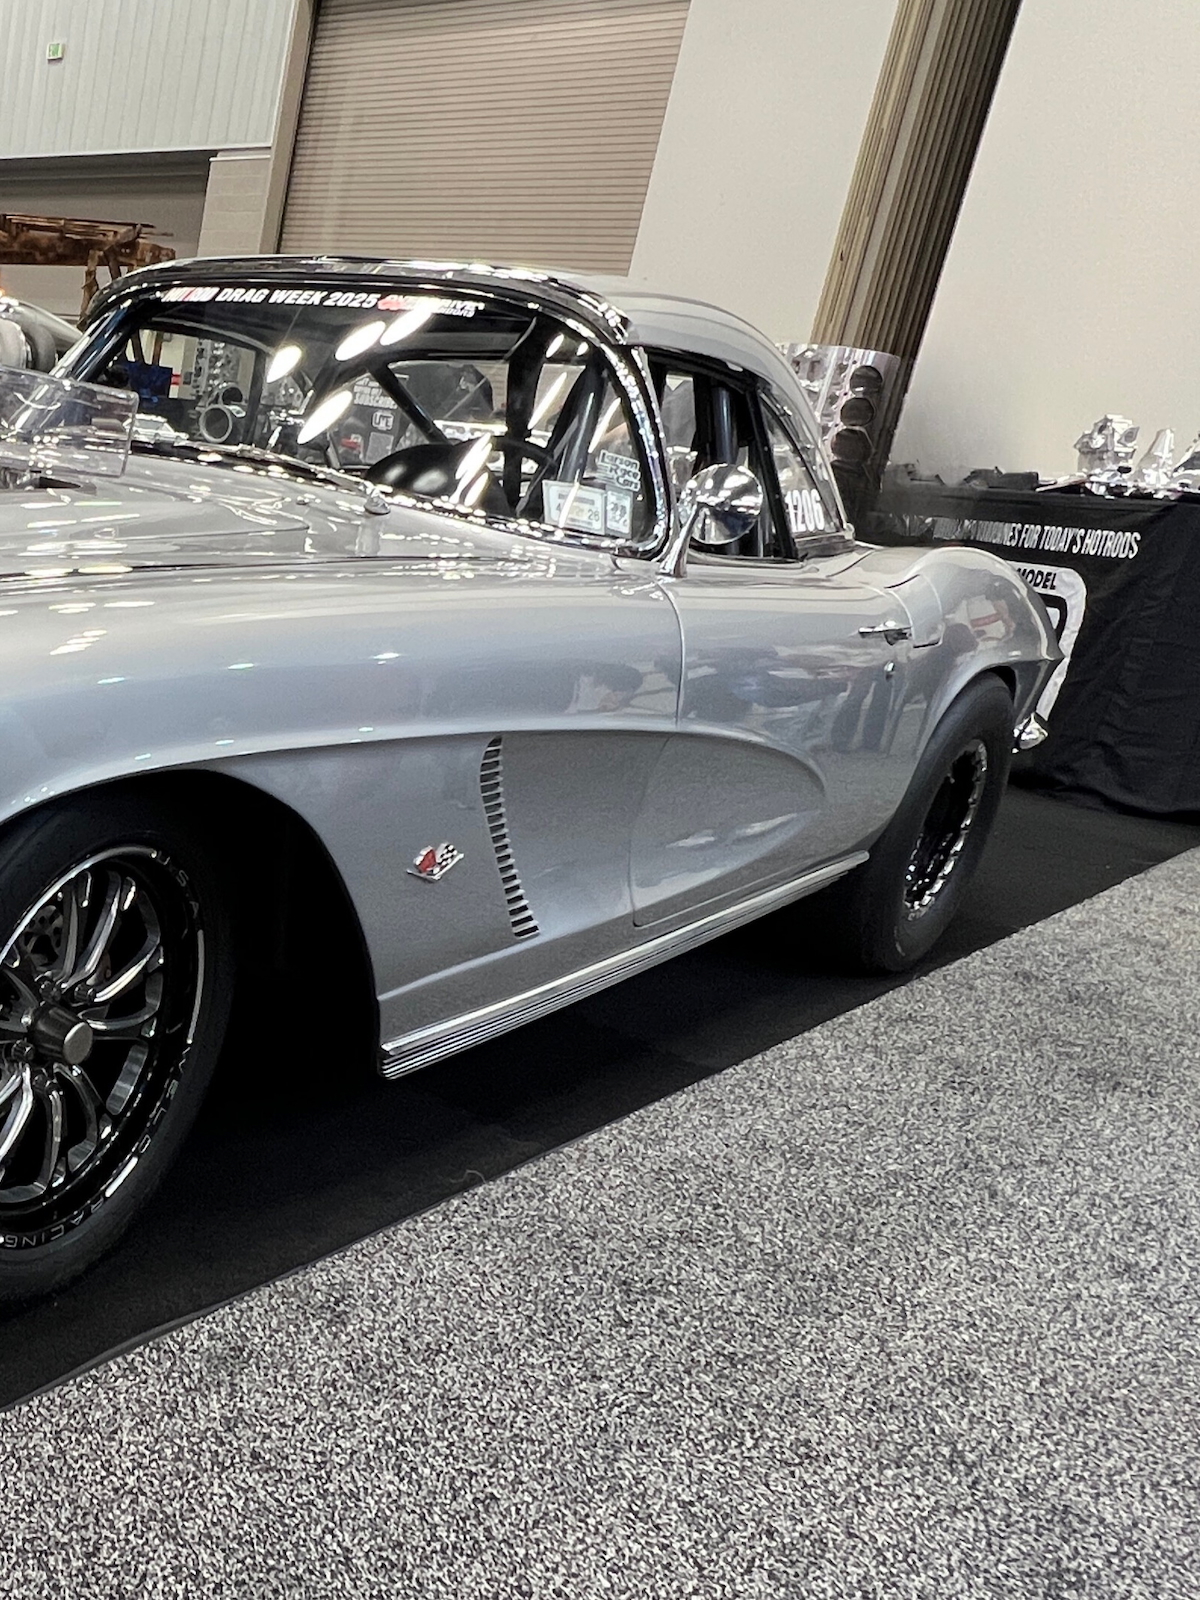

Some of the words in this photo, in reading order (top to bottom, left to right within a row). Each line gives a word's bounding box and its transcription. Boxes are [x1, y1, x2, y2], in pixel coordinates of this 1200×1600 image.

[215, 287, 270, 303] DRAG
[268, 289, 325, 305] WEEK
[323, 291, 380, 308] 2025
[600, 452, 639, 470] Larson
[609, 464, 639, 479] Race
[616, 476, 639, 490] Cars
[784, 488, 825, 532] 1206
[1019, 524, 1042, 549] FOR
[1039, 526, 1085, 554] TODAY'S
[1082, 529, 1141, 559] HOTRODS
